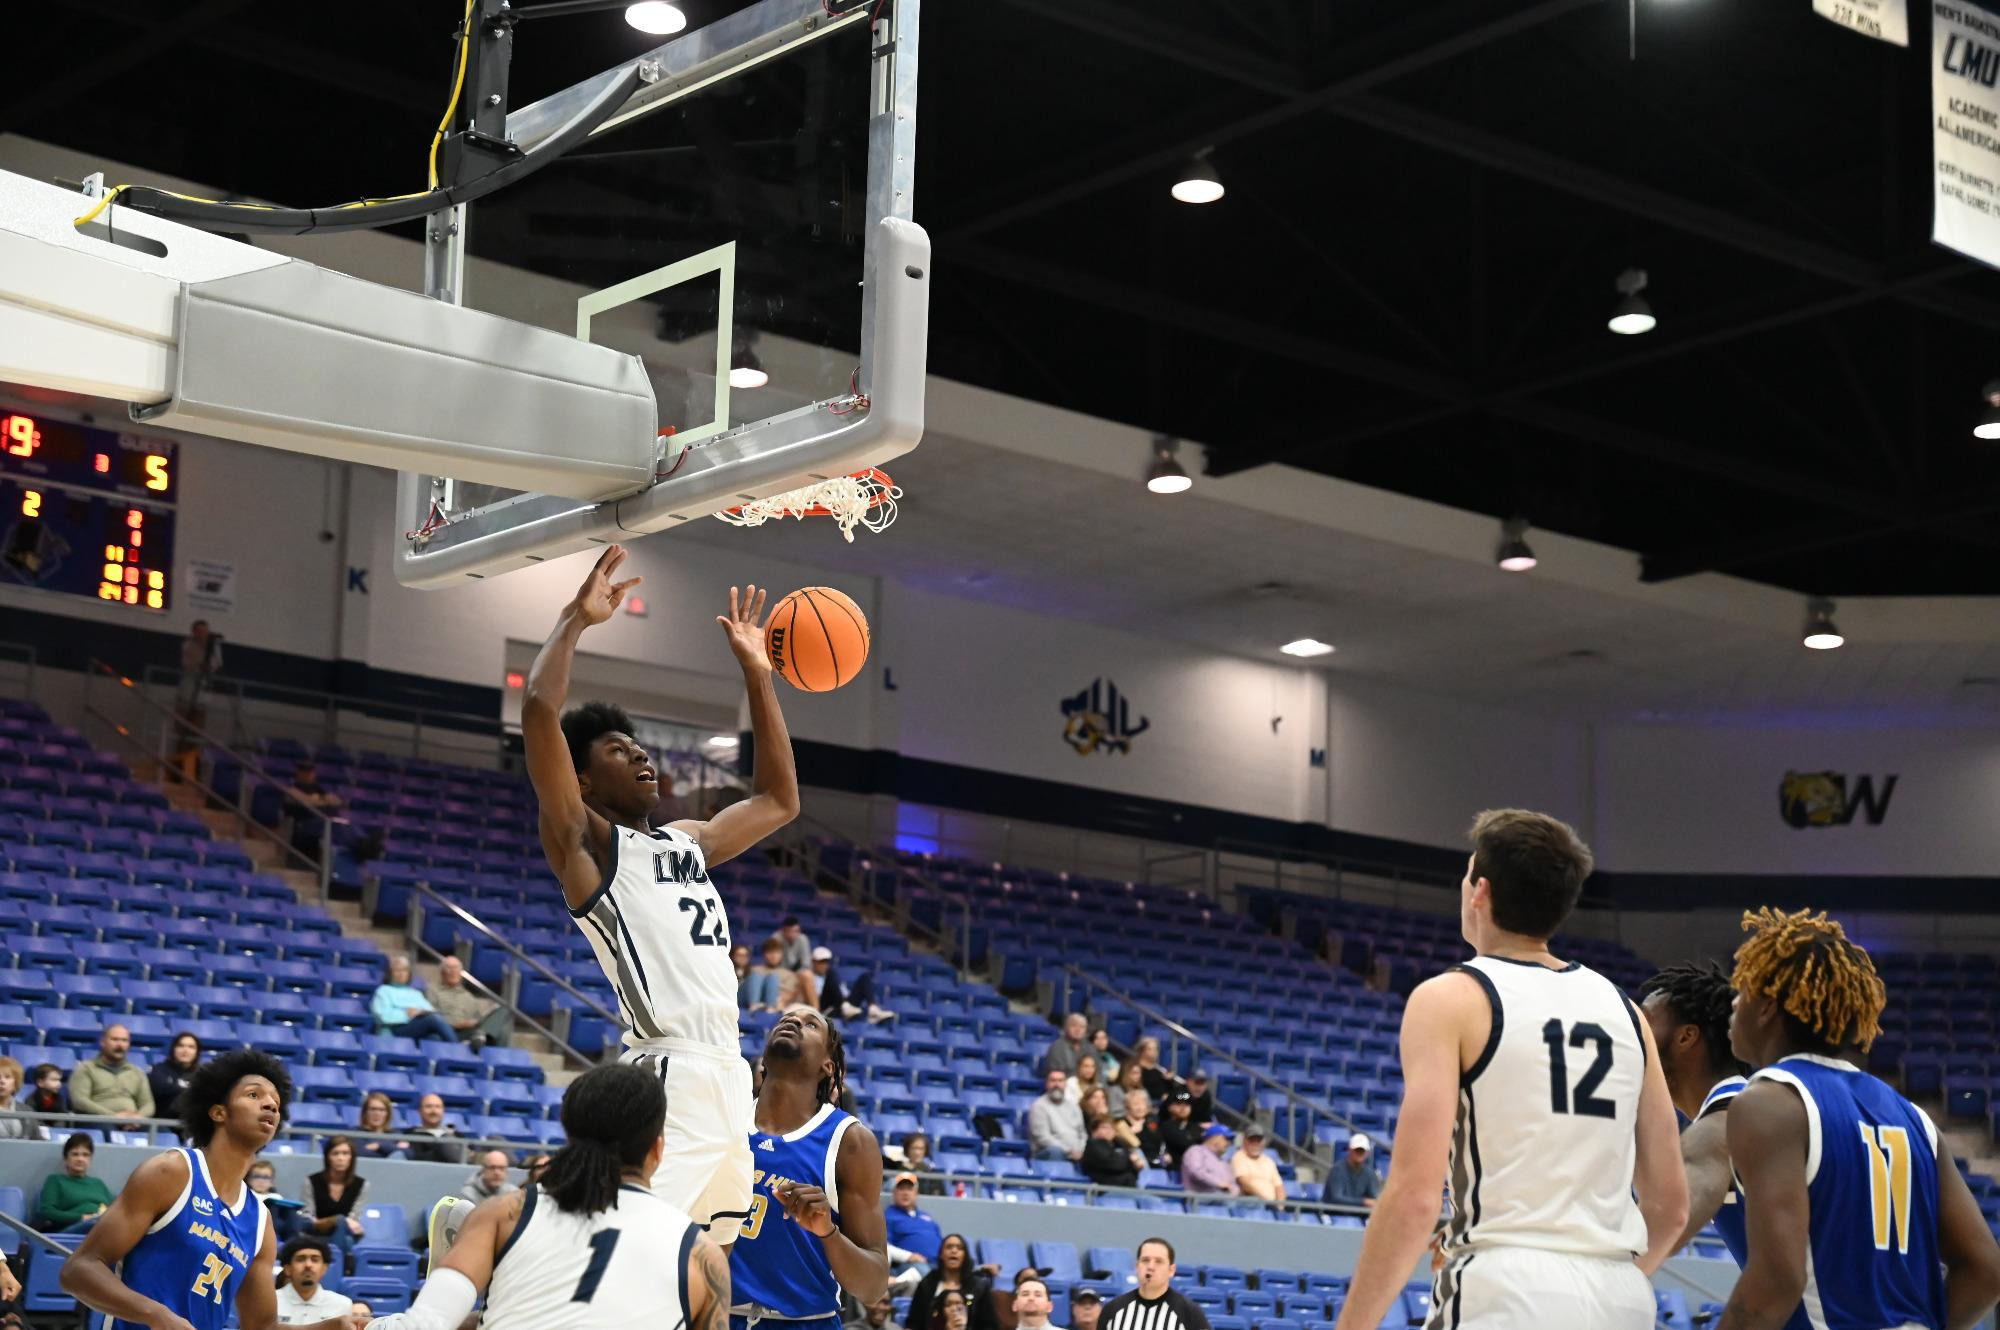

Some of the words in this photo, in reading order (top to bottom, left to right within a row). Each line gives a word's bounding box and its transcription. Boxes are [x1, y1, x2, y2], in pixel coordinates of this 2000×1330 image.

[1943, 32, 2000, 88] LMU
[145, 455, 168, 491] 5
[22, 490, 41, 518] 2
[348, 566, 369, 594] K
[884, 666, 897, 692] L
[653, 849, 710, 888] LMU
[678, 896, 728, 947] 22
[1542, 1018, 1617, 1120] 12
[192, 1196, 214, 1213] SAC
[1858, 1120, 1912, 1255] 11
[191, 1252, 234, 1305] 24
[568, 1226, 622, 1304] 1
